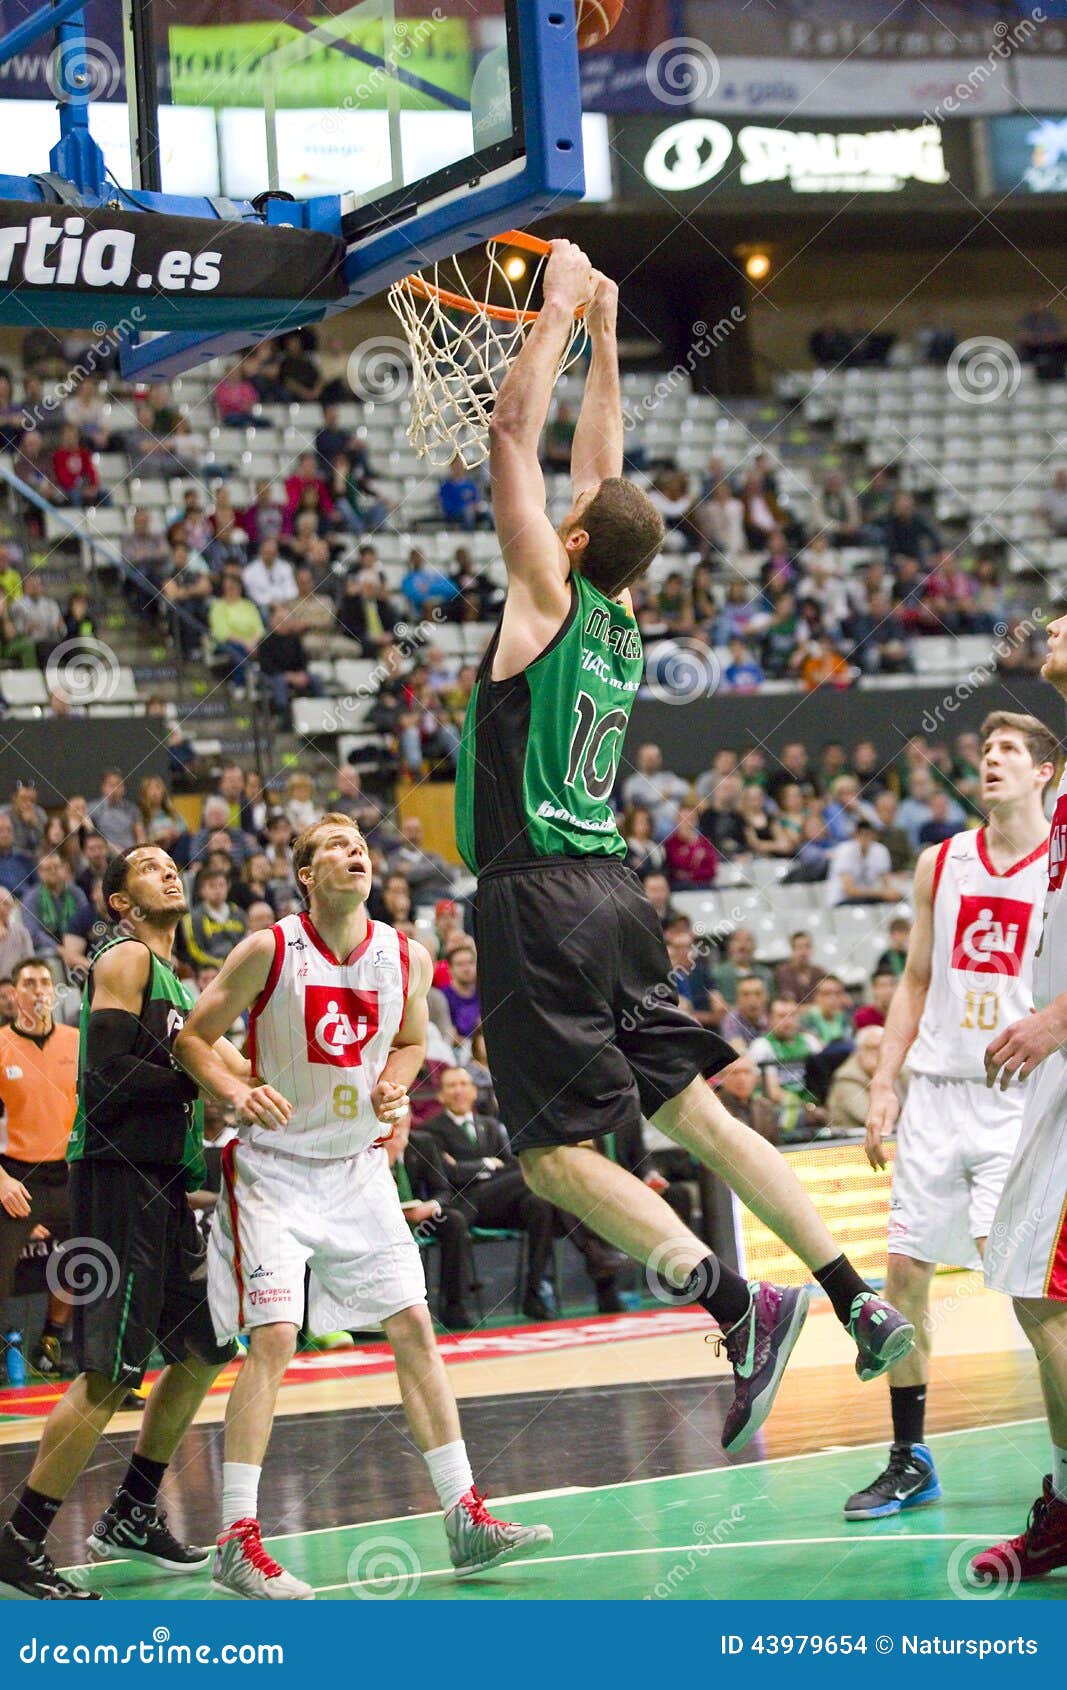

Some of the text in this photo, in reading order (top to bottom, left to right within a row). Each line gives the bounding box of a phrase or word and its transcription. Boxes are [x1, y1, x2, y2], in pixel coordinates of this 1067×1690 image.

[737, 126, 947, 185] SPALDING
[563, 690, 629, 800] 10
[960, 990, 998, 1031] 10
[332, 1084, 359, 1120] 8
